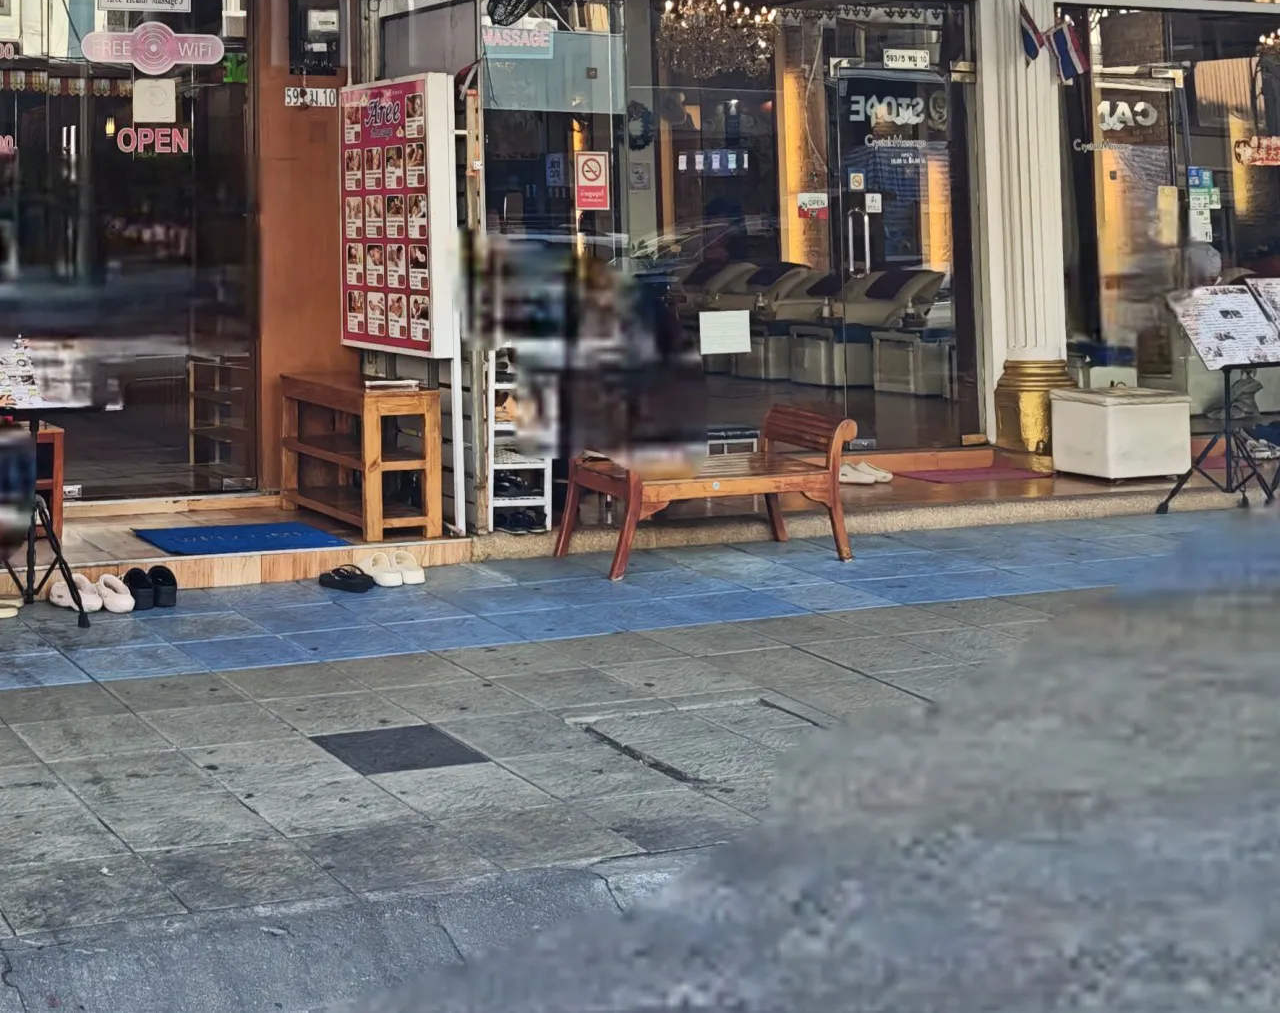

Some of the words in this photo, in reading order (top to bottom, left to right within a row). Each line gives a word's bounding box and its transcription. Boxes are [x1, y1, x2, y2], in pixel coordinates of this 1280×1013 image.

[91, 40, 131, 56] FREE
[177, 42, 213, 57] WiFi
[364, 98, 401, 127] Aree
[116, 128, 189, 153] OPEN
[808, 199, 825, 207] OPEN
